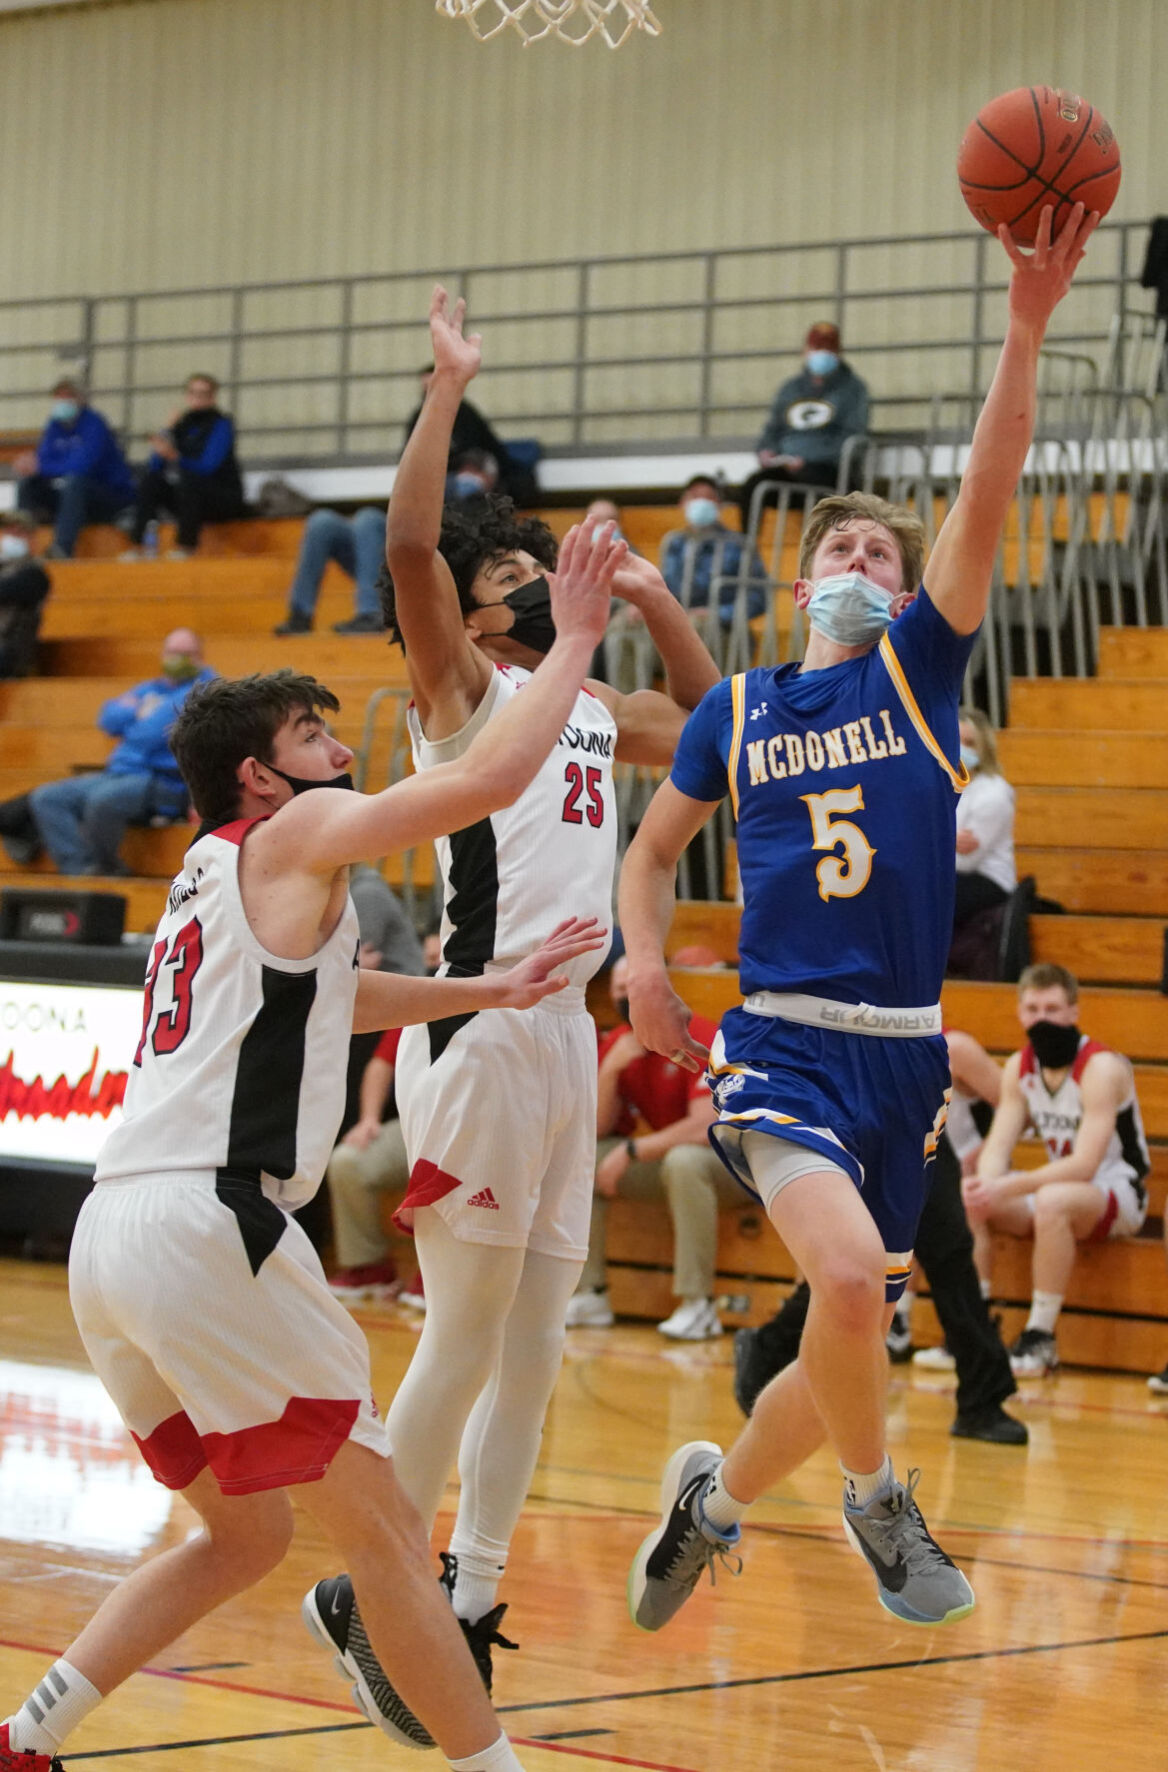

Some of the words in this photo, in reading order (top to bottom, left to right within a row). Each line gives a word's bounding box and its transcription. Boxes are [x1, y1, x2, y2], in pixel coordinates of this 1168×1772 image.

[559, 724, 612, 759] OONA
[746, 709, 907, 786] MCDONELL
[562, 761, 604, 829] 25
[798, 783, 878, 903] 5
[467, 1199, 499, 1210] adidas
